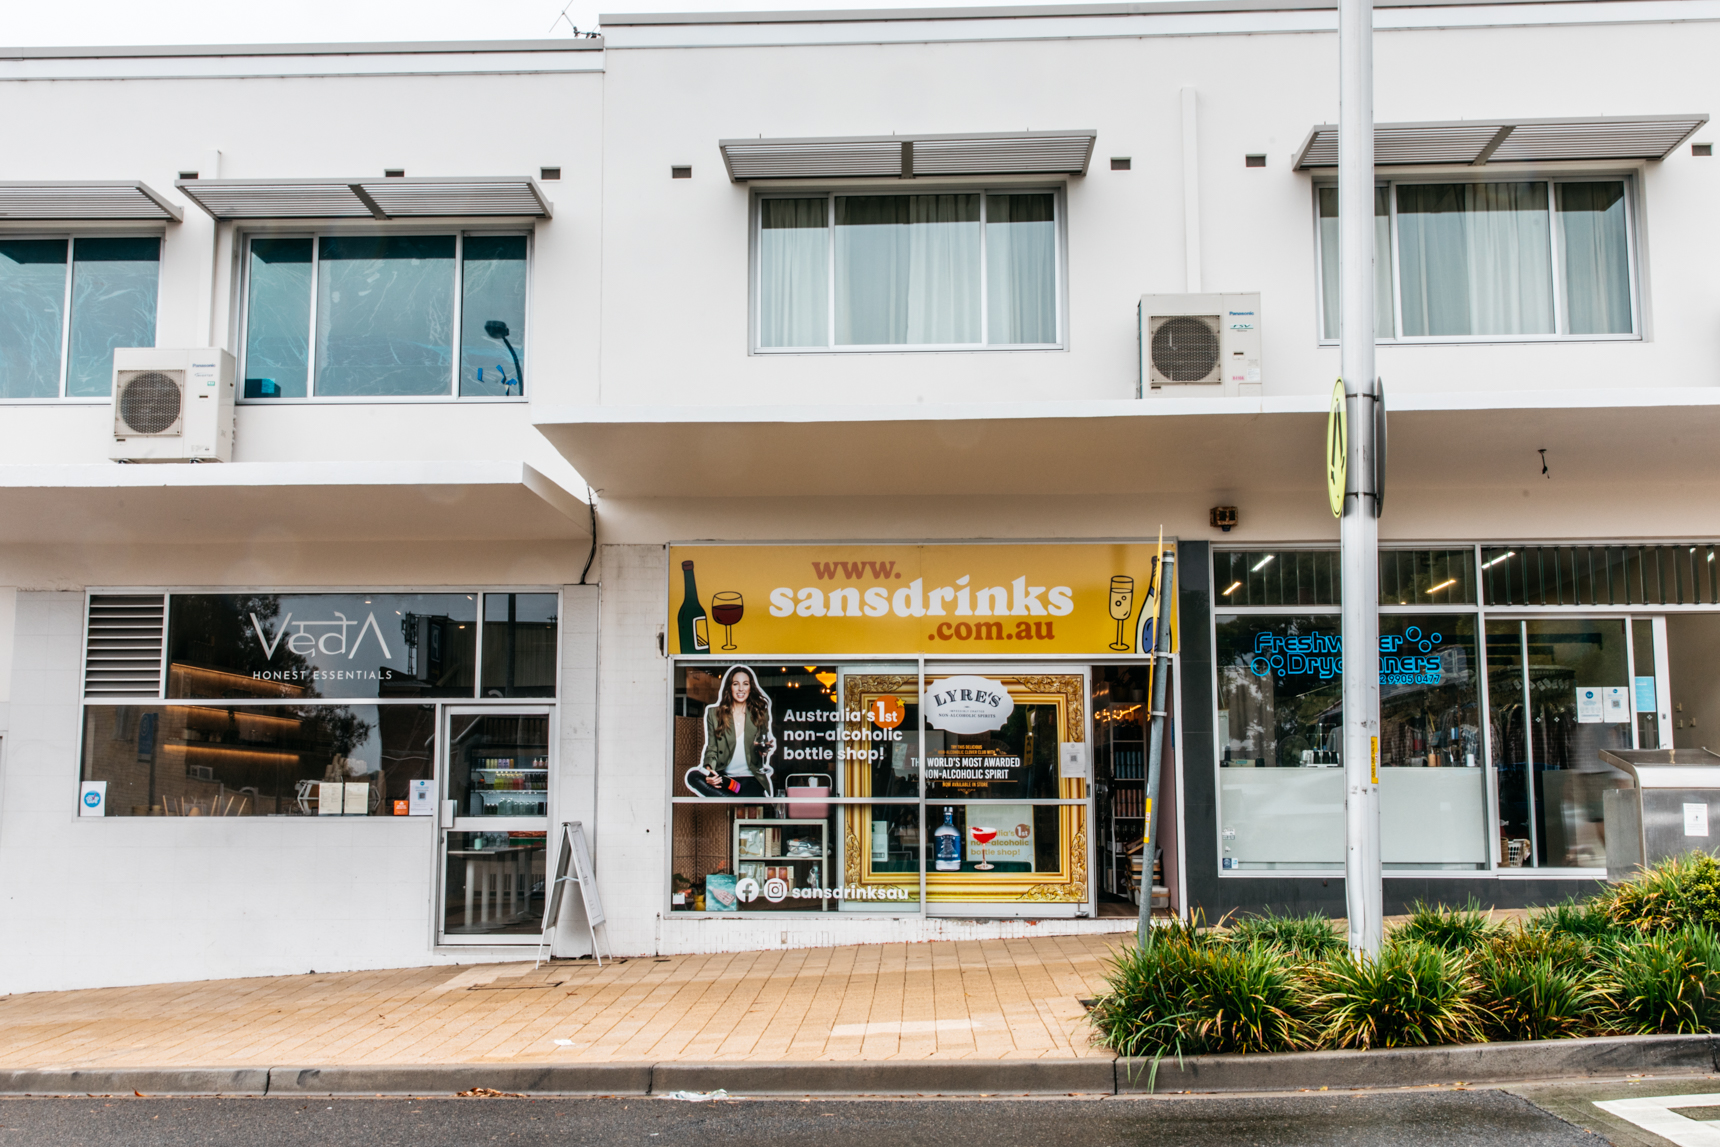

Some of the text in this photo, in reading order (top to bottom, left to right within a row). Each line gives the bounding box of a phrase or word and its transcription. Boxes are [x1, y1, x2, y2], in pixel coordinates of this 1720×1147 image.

[811, 561, 902, 580] www.
[769, 574, 1074, 618] sansdrinks
[927, 621, 1055, 641] .com.au
[1255, 631, 1404, 653] Freshwer
[1287, 653, 1441, 679] Drycners
[252, 670, 392, 680] HONEST ESSENTIALS
[1387, 674, 1414, 685] 9905
[1415, 674, 1441, 685] 0477
[933, 688, 1002, 708] LYRE'S
[783, 701, 898, 722] Australia's 1st
[783, 727, 903, 741] non-alcoholic
[783, 746, 884, 765] bottle shop!
[910, 757, 1020, 767] TH WORLD'S MOST AWARDED
[985, 769, 1009, 779] SPIRIT
[1017, 826, 1028, 837] 1st
[997, 848, 1021, 858] shop!
[791, 885, 909, 900] sansdrinksau
